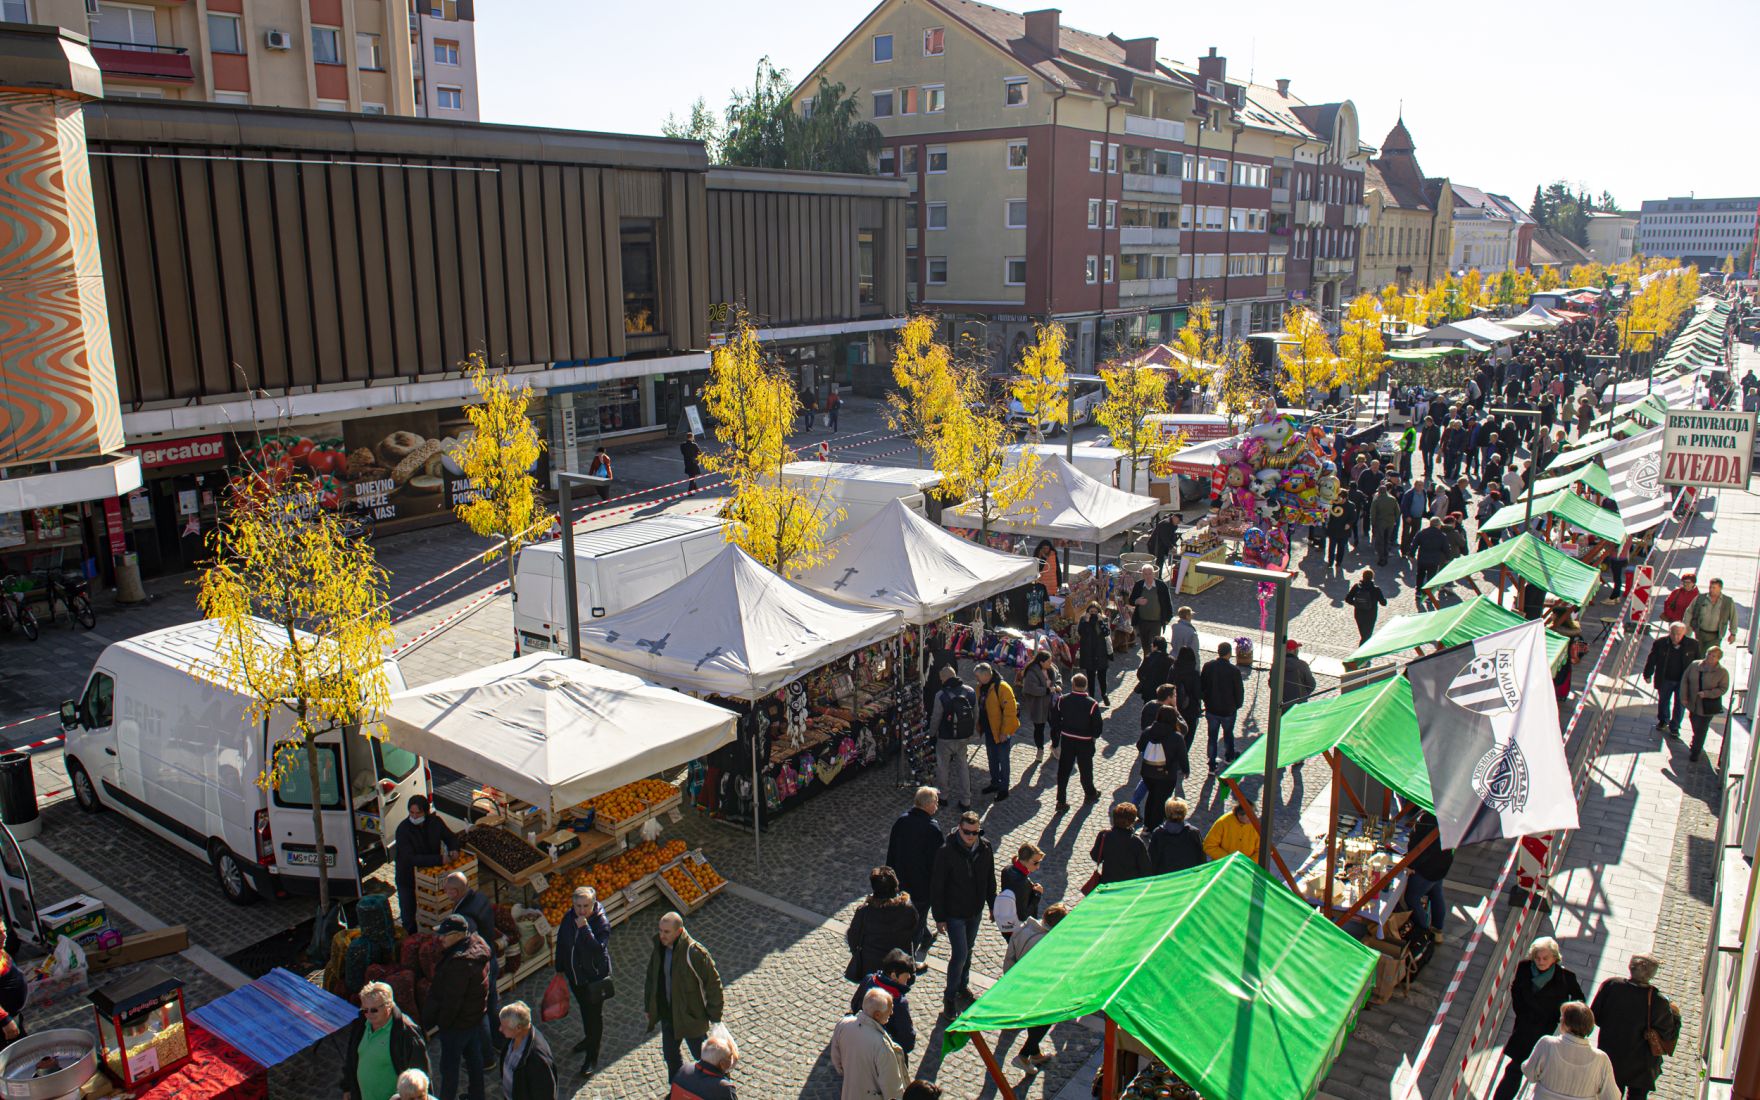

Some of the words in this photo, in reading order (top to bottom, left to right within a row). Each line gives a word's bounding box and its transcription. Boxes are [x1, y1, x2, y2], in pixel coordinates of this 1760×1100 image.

[1668, 415, 1749, 433] RESTAVRACIJA
[1676, 434, 1688, 446] IN
[1690, 433, 1737, 449] PIVNICA
[1664, 452, 1742, 484] ZVEZDA
[355, 478, 395, 496] DNEVNO
[374, 505, 396, 520] VAS!
[1500, 672, 1519, 708] MURA
[1473, 749, 1498, 780] MURSKA
